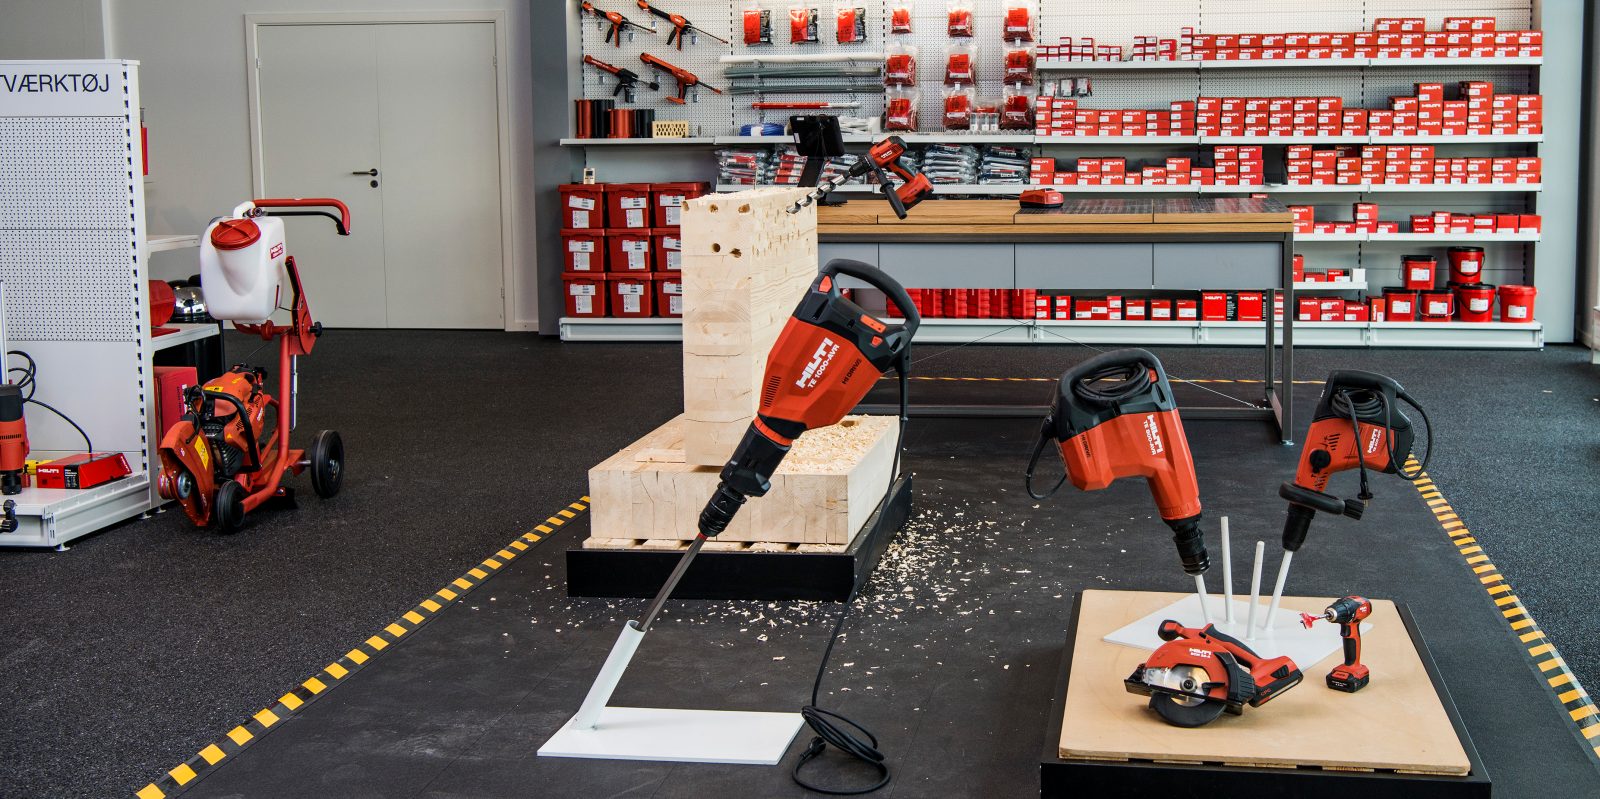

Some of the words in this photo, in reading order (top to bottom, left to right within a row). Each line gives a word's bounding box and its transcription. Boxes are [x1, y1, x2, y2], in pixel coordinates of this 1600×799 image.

[796, 337, 834, 388] HILTI
[808, 378, 817, 388] TE
[815, 344, 840, 378] 1000-AVR
[1147, 414, 1164, 454] HILTI
[1367, 428, 1378, 453] HILTI
